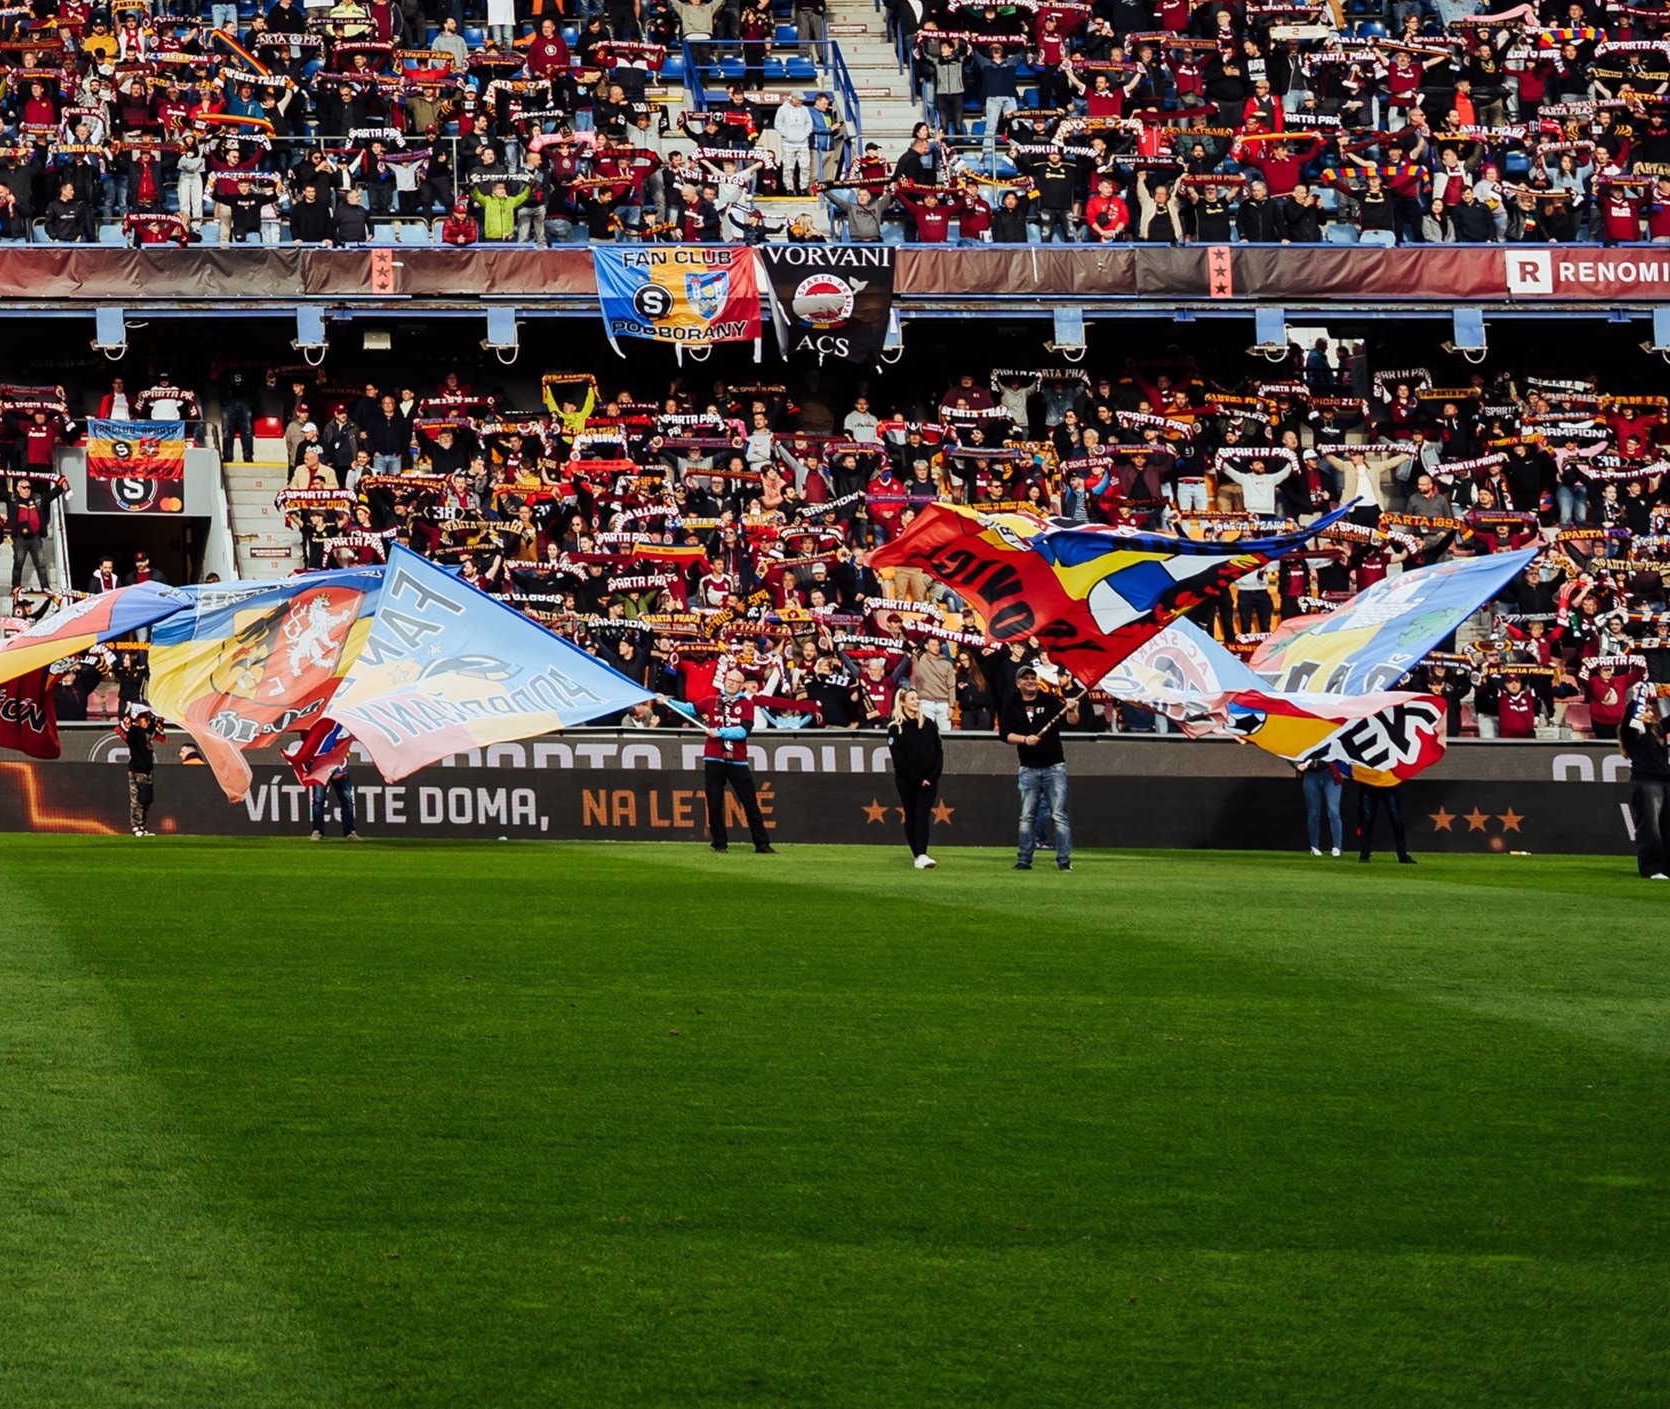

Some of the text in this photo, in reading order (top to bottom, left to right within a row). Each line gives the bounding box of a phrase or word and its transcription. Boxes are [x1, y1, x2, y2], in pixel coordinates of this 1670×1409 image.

[704, 149, 745, 158] SPARTA
[747, 149, 775, 170] PRAHA
[623, 249, 733, 268] FAN CLUB
[767, 246, 892, 267] VORVANI
[797, 276, 834, 298] SPARTA
[796, 334, 850, 357] ACS
[1428, 464, 1439, 477] AC
[1439, 461, 1475, 473] SPARTA
[286, 490, 331, 499] SPARTA
[1432, 517, 1461, 529] 1893
[868, 598, 912, 610] SPARTA
[641, 614, 701, 623] SPARTA PRAHA
[917, 624, 961, 642] SPARTA
[1583, 655, 1628, 670] SPARTA
[419, 786, 550, 830] DOMA,
[582, 788, 646, 827] NA
